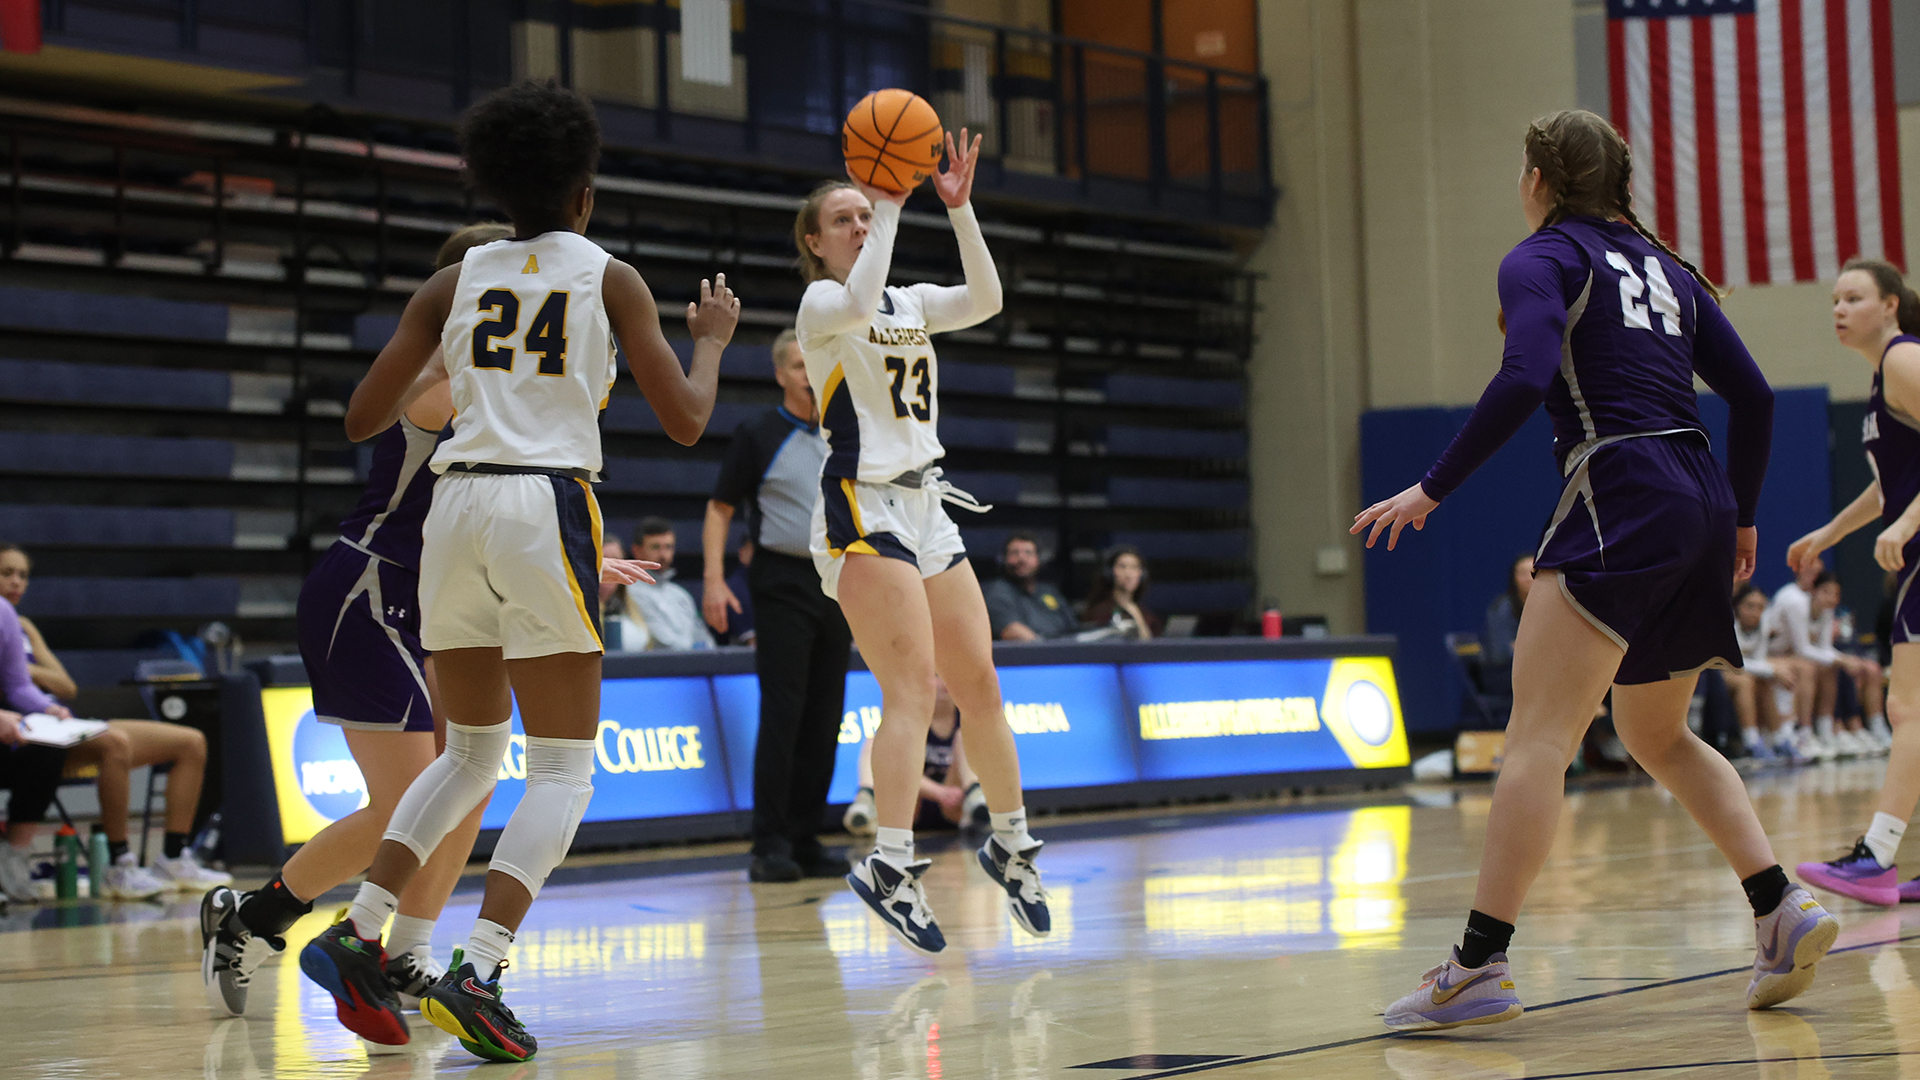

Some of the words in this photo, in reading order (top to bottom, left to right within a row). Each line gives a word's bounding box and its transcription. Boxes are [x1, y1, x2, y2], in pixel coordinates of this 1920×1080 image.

[521, 254, 540, 275] A
[1605, 250, 1682, 337] 24
[472, 287, 571, 378] 24
